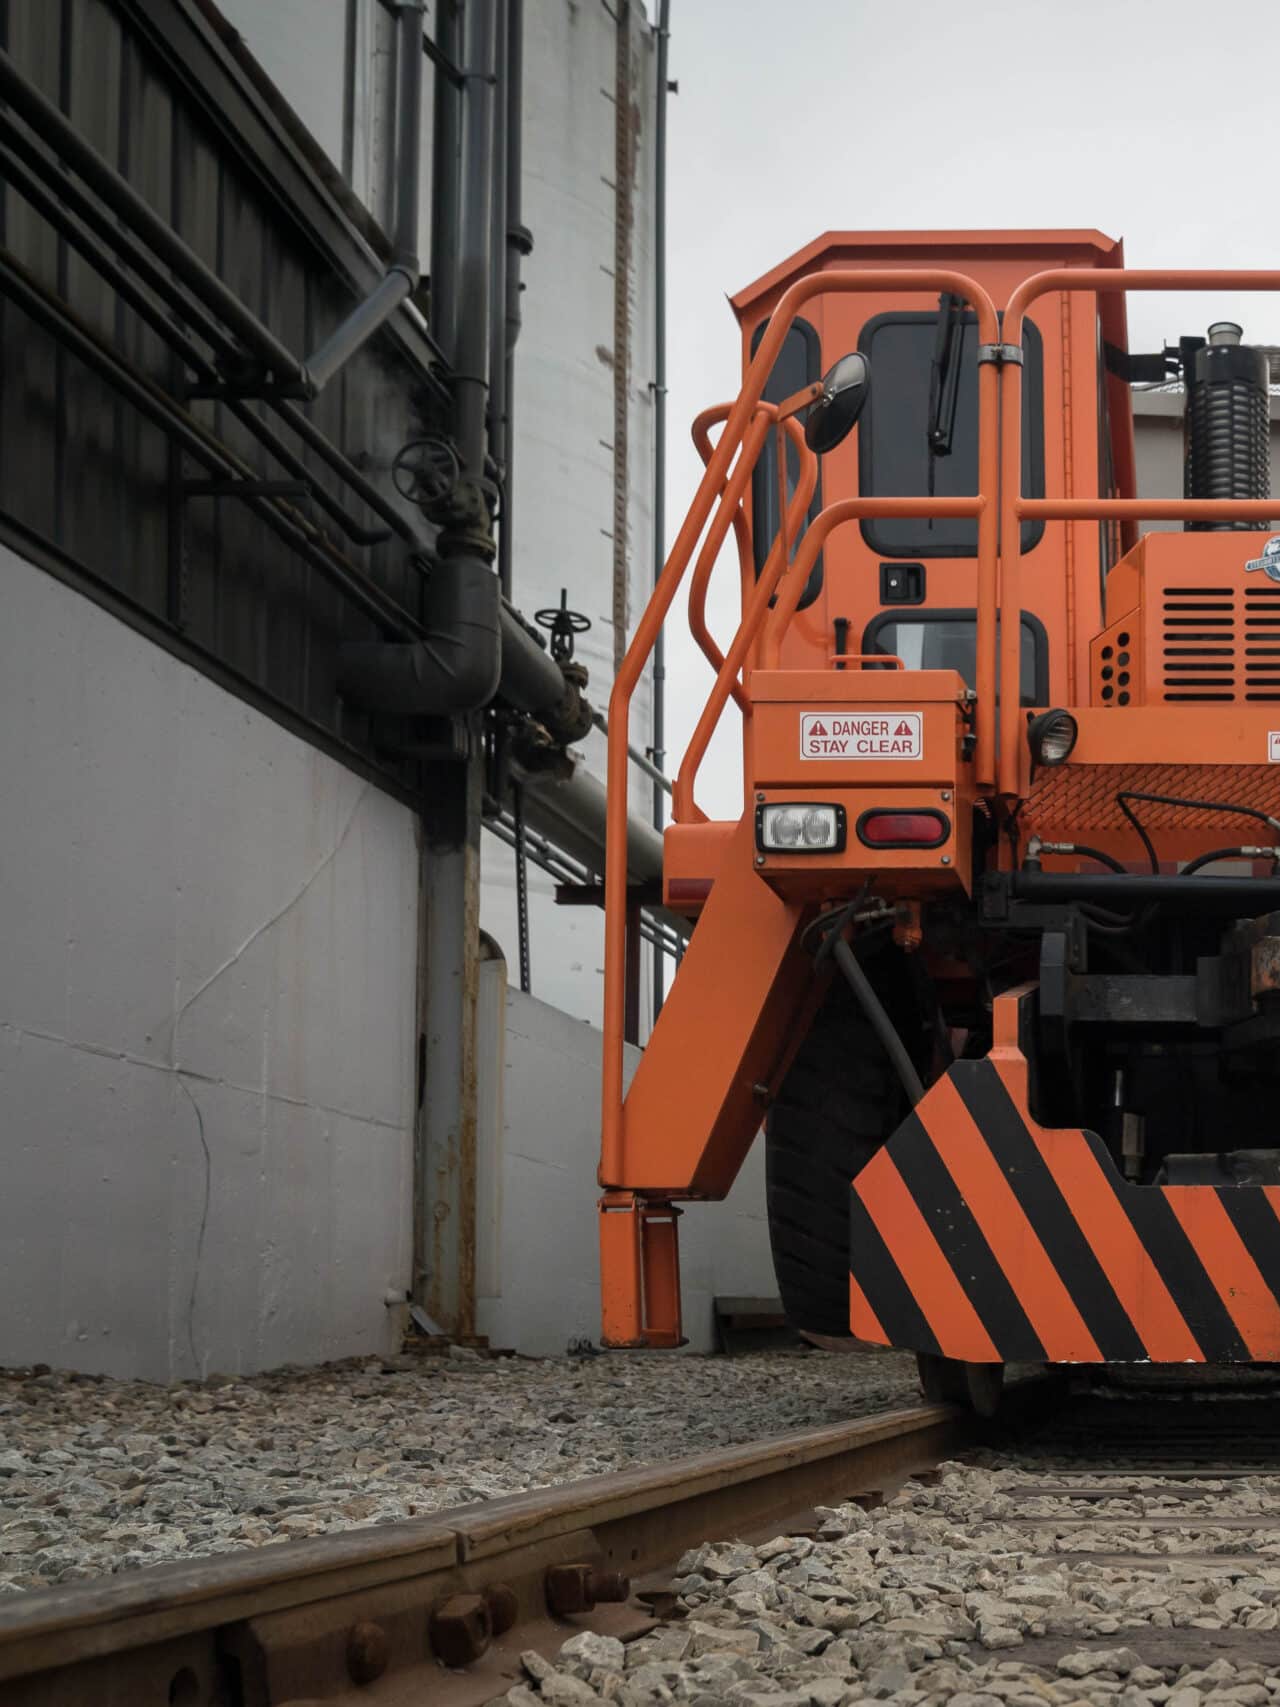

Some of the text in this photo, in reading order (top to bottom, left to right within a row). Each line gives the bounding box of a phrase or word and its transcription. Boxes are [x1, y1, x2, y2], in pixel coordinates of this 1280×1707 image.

[832, 720, 889, 736] DANGER
[809, 739, 913, 754] STAY CLEAR
